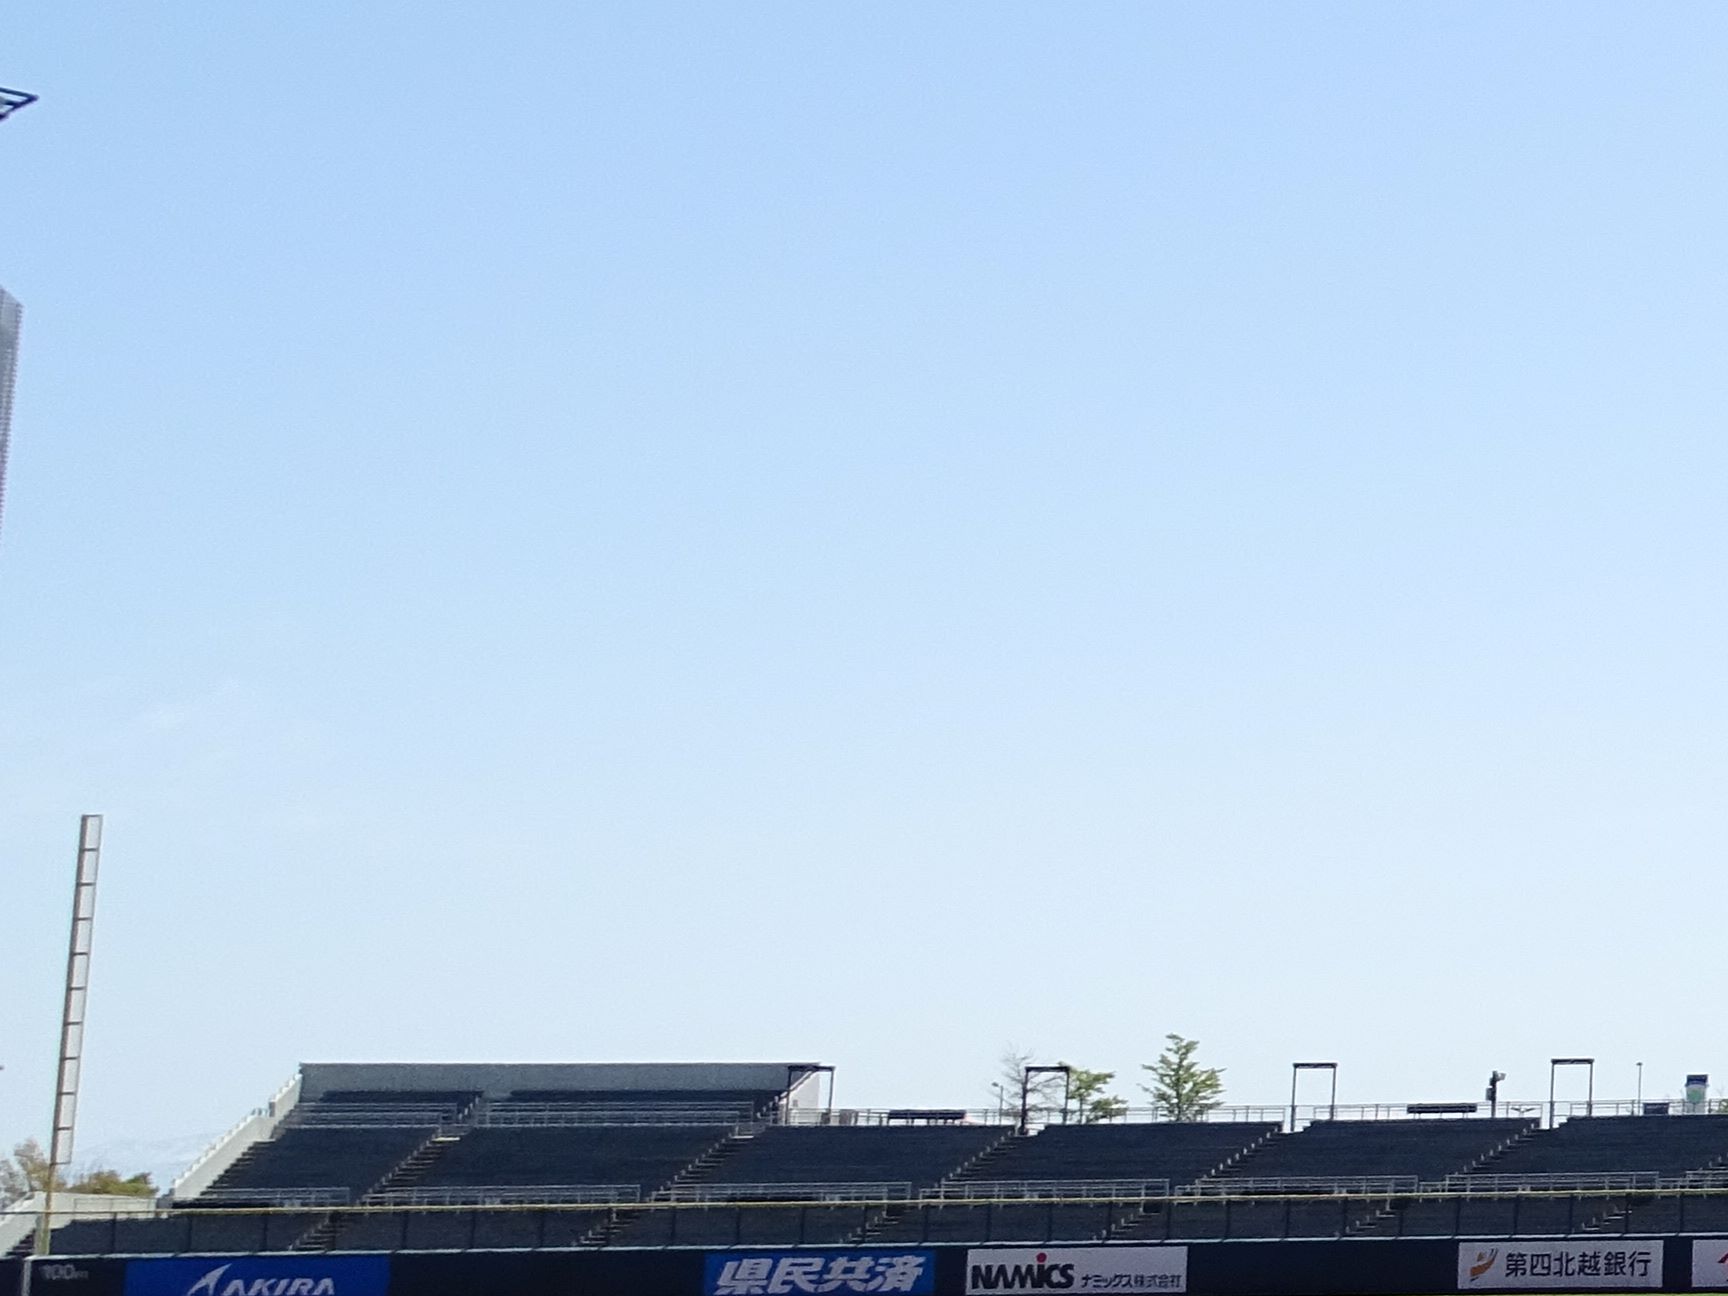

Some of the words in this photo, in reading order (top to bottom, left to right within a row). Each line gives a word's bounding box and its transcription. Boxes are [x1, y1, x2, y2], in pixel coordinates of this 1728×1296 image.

[713, 1255, 926, 1295] 県民共済
[1505, 1250, 1652, 1277] 第四北越銀行
[222, 1277, 335, 1296] AKIRA
[1081, 1274, 1181, 1289] ナミックス株式会社
